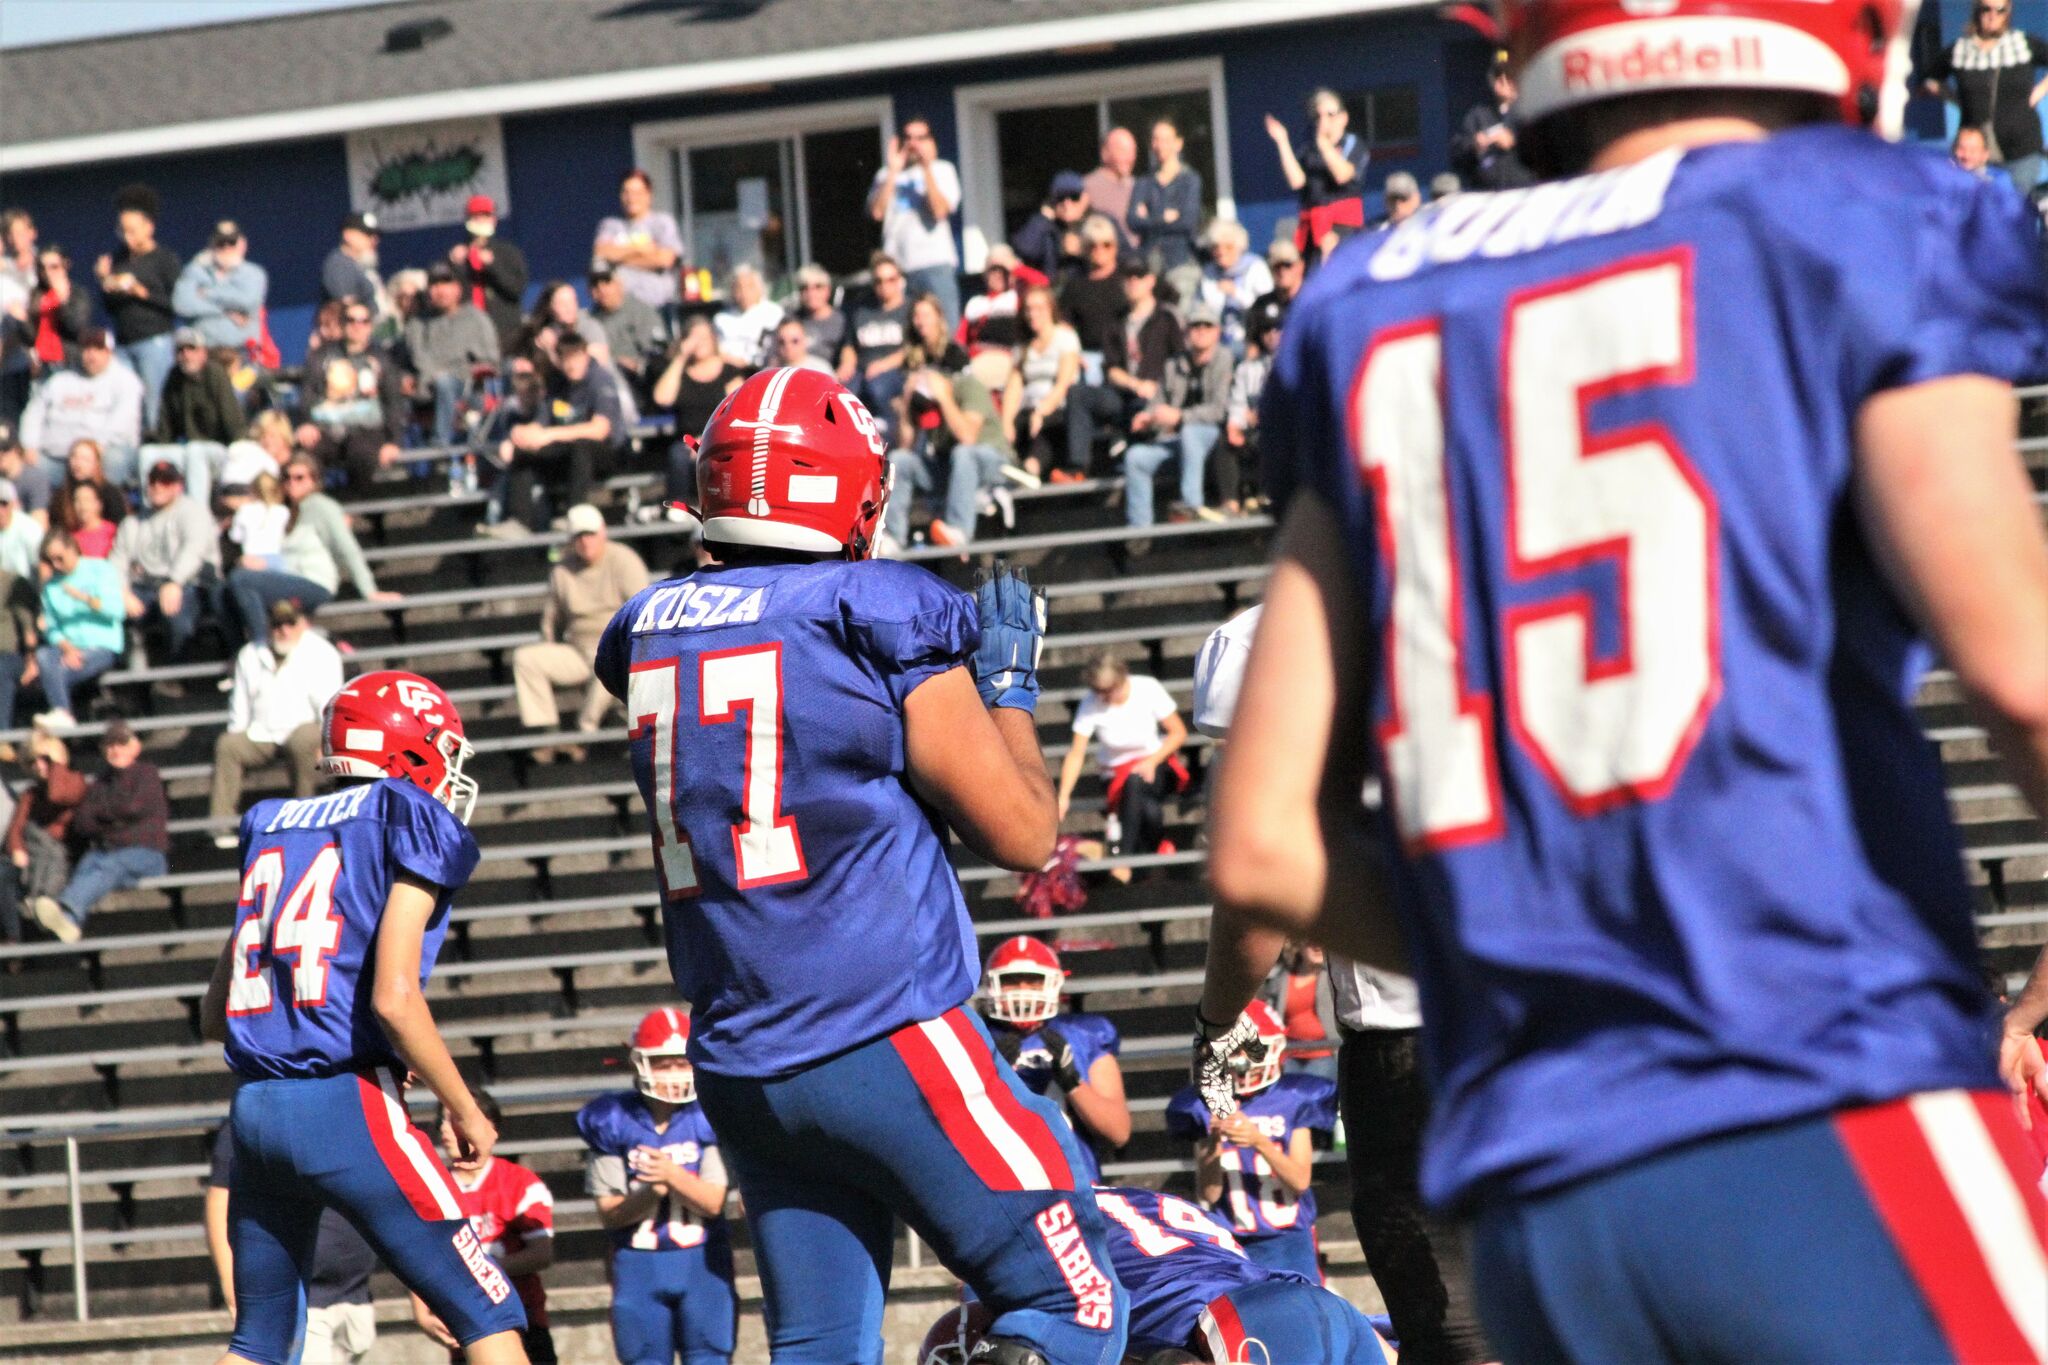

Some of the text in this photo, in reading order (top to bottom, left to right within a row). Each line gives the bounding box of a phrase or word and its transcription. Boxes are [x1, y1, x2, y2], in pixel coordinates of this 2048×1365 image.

[1563, 35, 1763, 91] Riddell
[1346, 245, 1723, 855] 15
[631, 582, 764, 632] KOSZA
[265, 784, 370, 832] POTTER
[628, 641, 808, 900] 77
[226, 842, 344, 1017] 24
[451, 1223, 511, 1305] SABERS
[1034, 1199, 1114, 1332] SABERS
